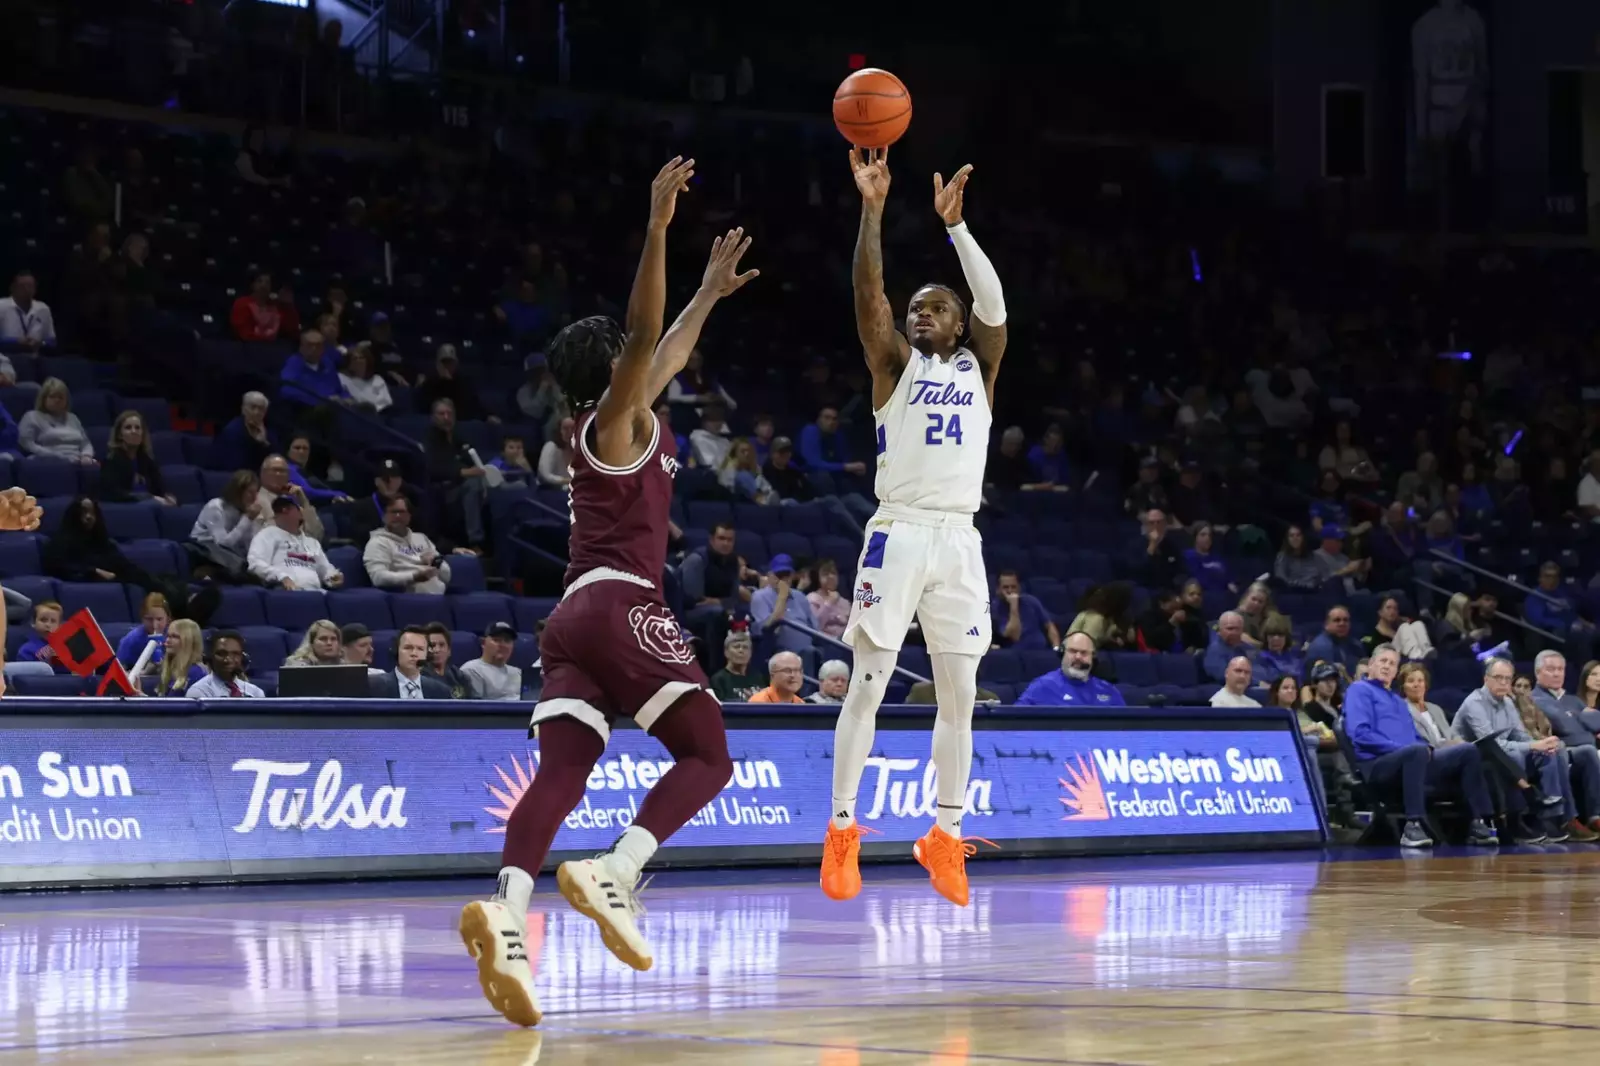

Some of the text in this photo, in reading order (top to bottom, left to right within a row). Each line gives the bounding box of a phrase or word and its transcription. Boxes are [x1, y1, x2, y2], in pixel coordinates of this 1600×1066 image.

[909, 380, 974, 406] Tulsa
[925, 413, 963, 445] 24
[855, 588, 882, 604] Tulsa
[37, 751, 133, 798] Sun
[724, 760, 781, 789] un
[1093, 748, 1283, 784] Western Sun
[231, 758, 408, 833] Tulsa
[863, 756, 993, 820] Tula
[1106, 786, 1293, 818] Federal Credit Union
[48, 807, 141, 841] Union
[564, 794, 637, 829] ederal
[720, 797, 790, 825] Union
